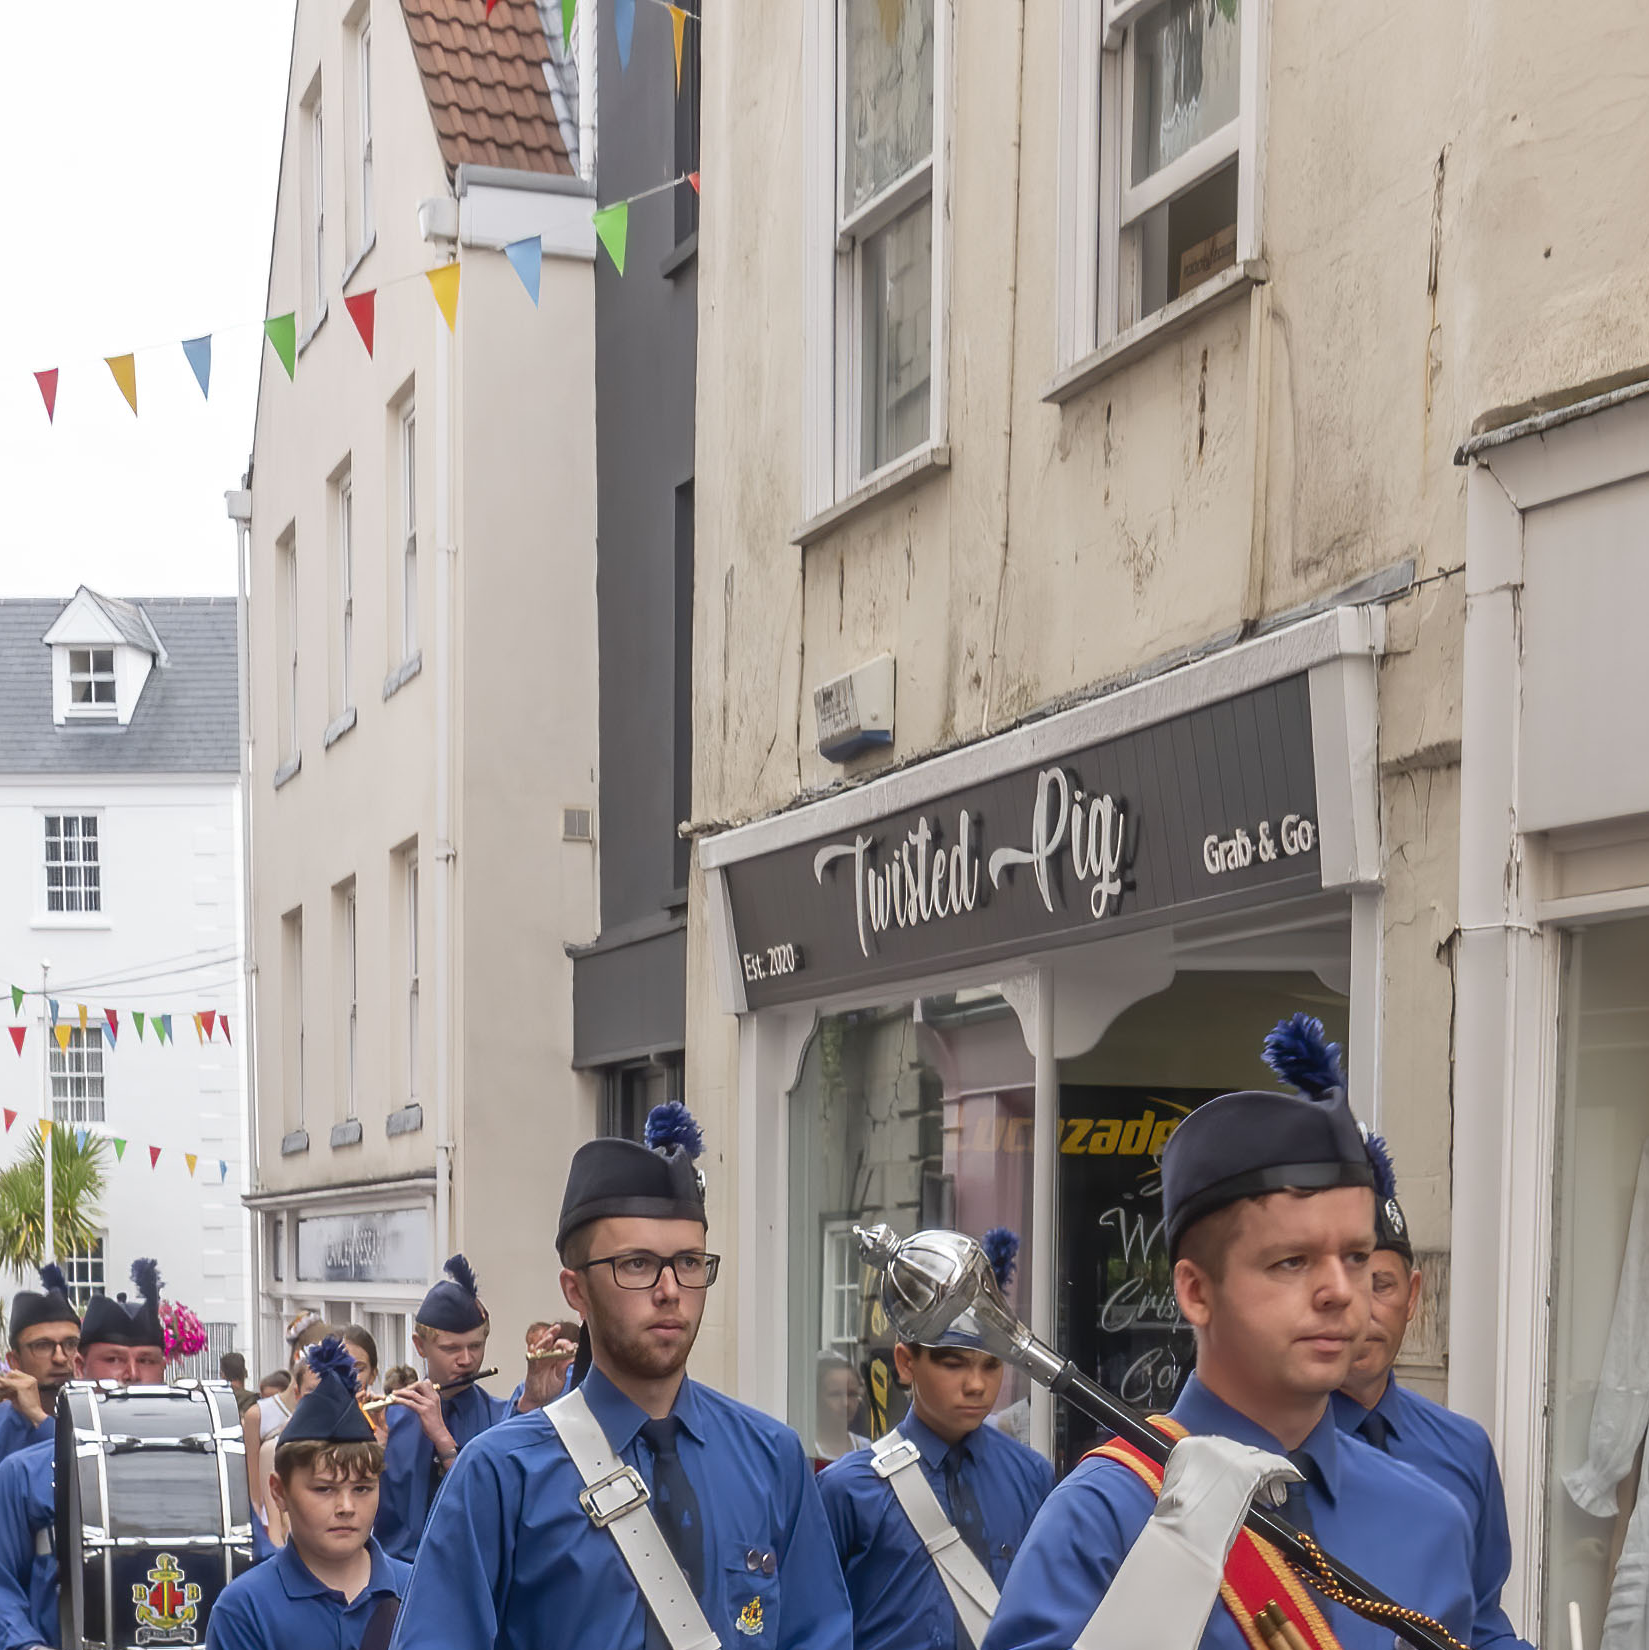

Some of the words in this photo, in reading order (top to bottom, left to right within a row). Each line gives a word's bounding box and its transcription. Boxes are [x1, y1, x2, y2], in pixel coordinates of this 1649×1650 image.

[814, 808, 978, 958] Twisted
[989, 766, 1123, 919] Pig
[1204, 828, 1252, 874] Grab
[1259, 821, 1277, 862] &
[1281, 814, 1313, 856] Go
[743, 953, 766, 981] Est.
[767, 943, 795, 976] 2020
